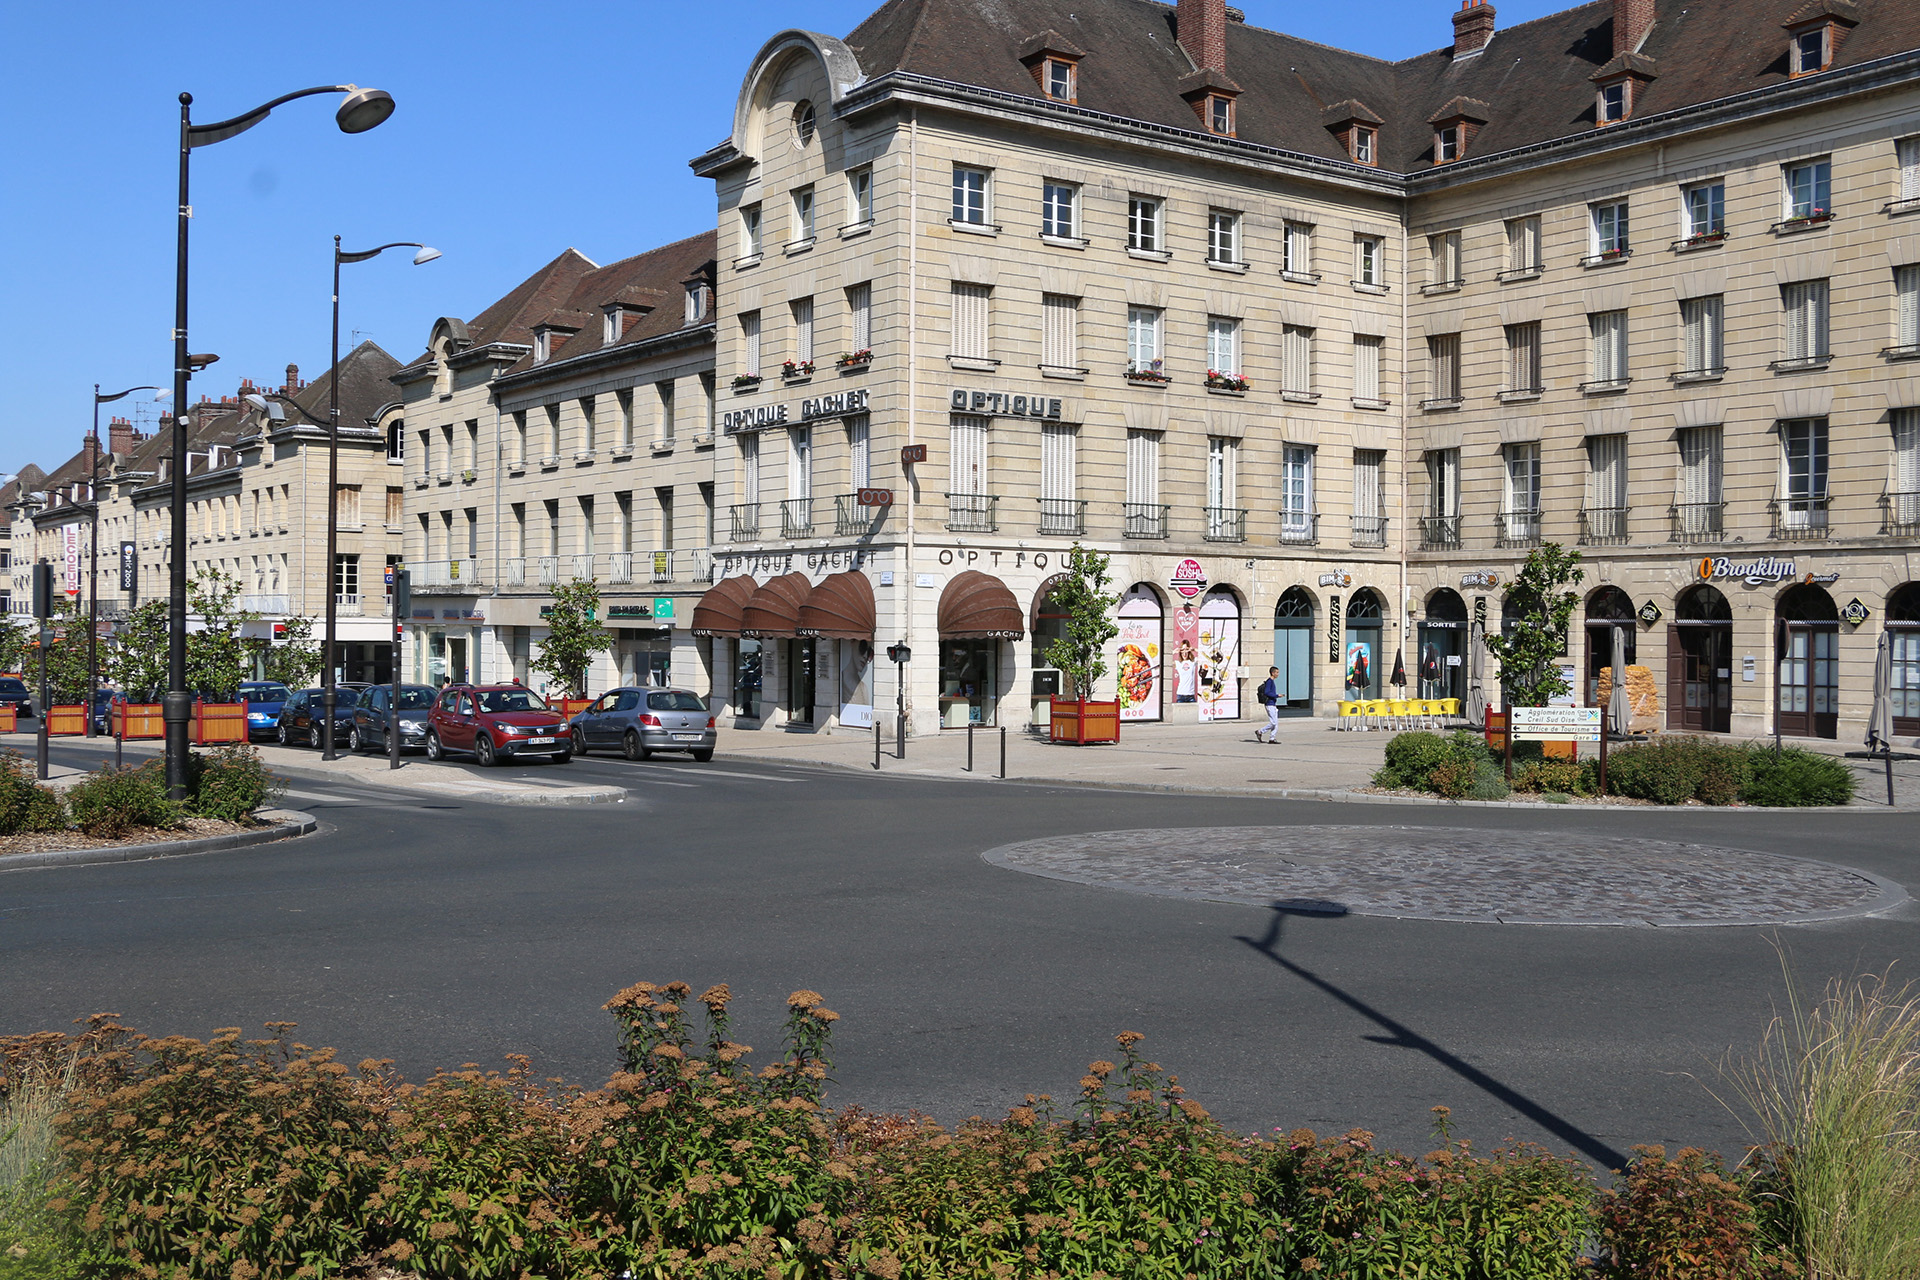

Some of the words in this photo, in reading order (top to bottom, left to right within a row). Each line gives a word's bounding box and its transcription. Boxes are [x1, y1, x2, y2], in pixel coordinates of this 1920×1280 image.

[724, 404, 788, 432] OPTIQUE
[801, 389, 870, 419] GACHET
[952, 389, 1062, 417] OPTIQUE
[66, 527, 77, 590] LECOEUR
[725, 554, 794, 573] OPTIQUE
[807, 549, 877, 569] GACHET
[938, 549, 1091, 573] OPTIQU
[1700, 556, 1796, 585] O'Brooklyn
[124, 569, 132, 588] 2000
[1177, 568, 1201, 578] SUSHI
[1327, 600, 1341, 660] Burger
[860, 711, 872, 721] DIO
[1528, 709, 1576, 717] Agglomération
